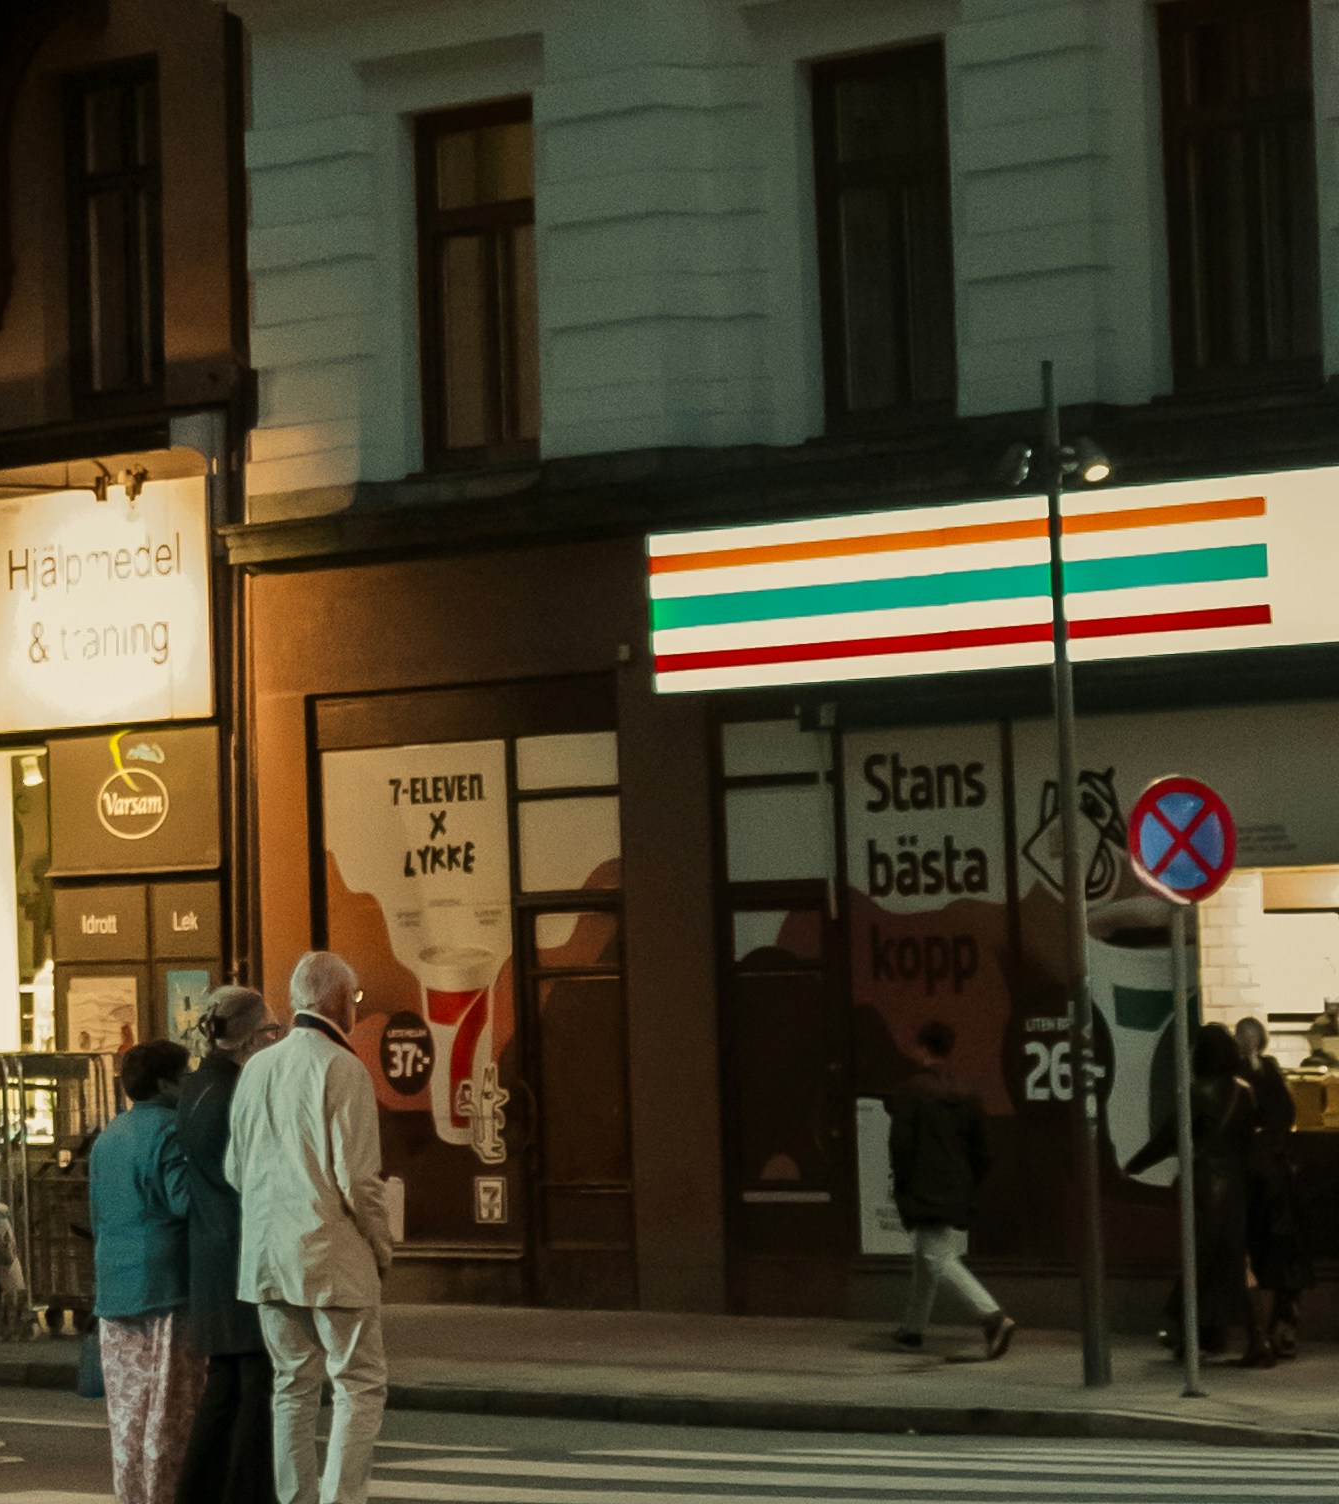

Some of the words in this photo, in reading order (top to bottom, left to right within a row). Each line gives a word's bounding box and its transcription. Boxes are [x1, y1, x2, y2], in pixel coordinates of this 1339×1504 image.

[7, 532, 181, 602] Hjälpmedel
[28, 622, 50, 665] &
[103, 791, 163, 816] Varsam
[863, 752, 988, 813] Stans
[403, 840, 476, 878] LYKKE
[866, 834, 989, 897] bästa
[172, 911, 199, 932] Lek
[870, 922, 980, 997] kopp
